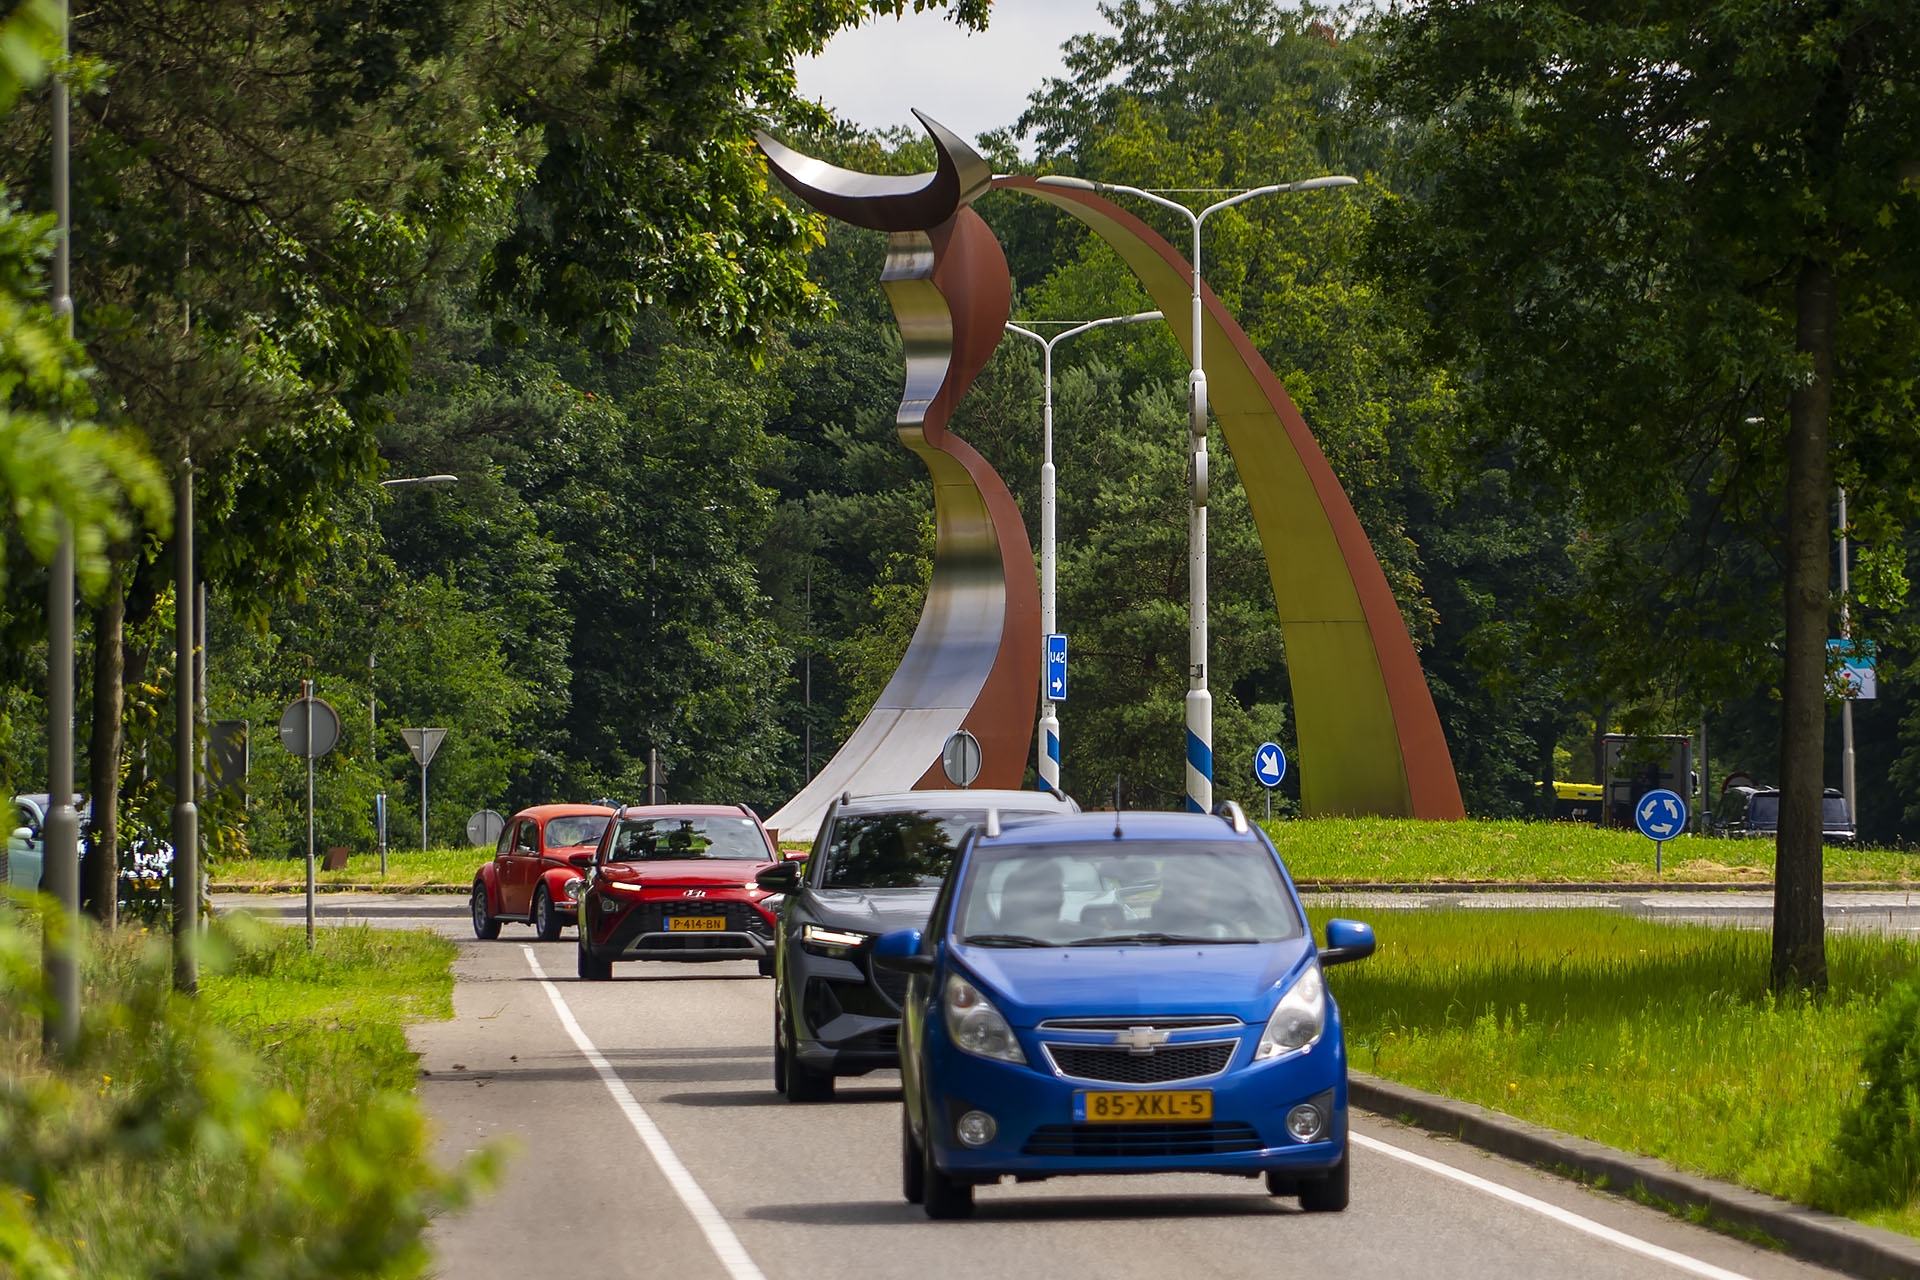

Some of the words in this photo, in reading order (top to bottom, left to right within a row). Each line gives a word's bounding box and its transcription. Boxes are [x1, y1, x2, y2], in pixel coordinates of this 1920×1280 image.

[1050, 651, 1065, 664] U42
[673, 919, 721, 929] P-414-BN
[1095, 1094, 1204, 1116] 85-XKL-5
